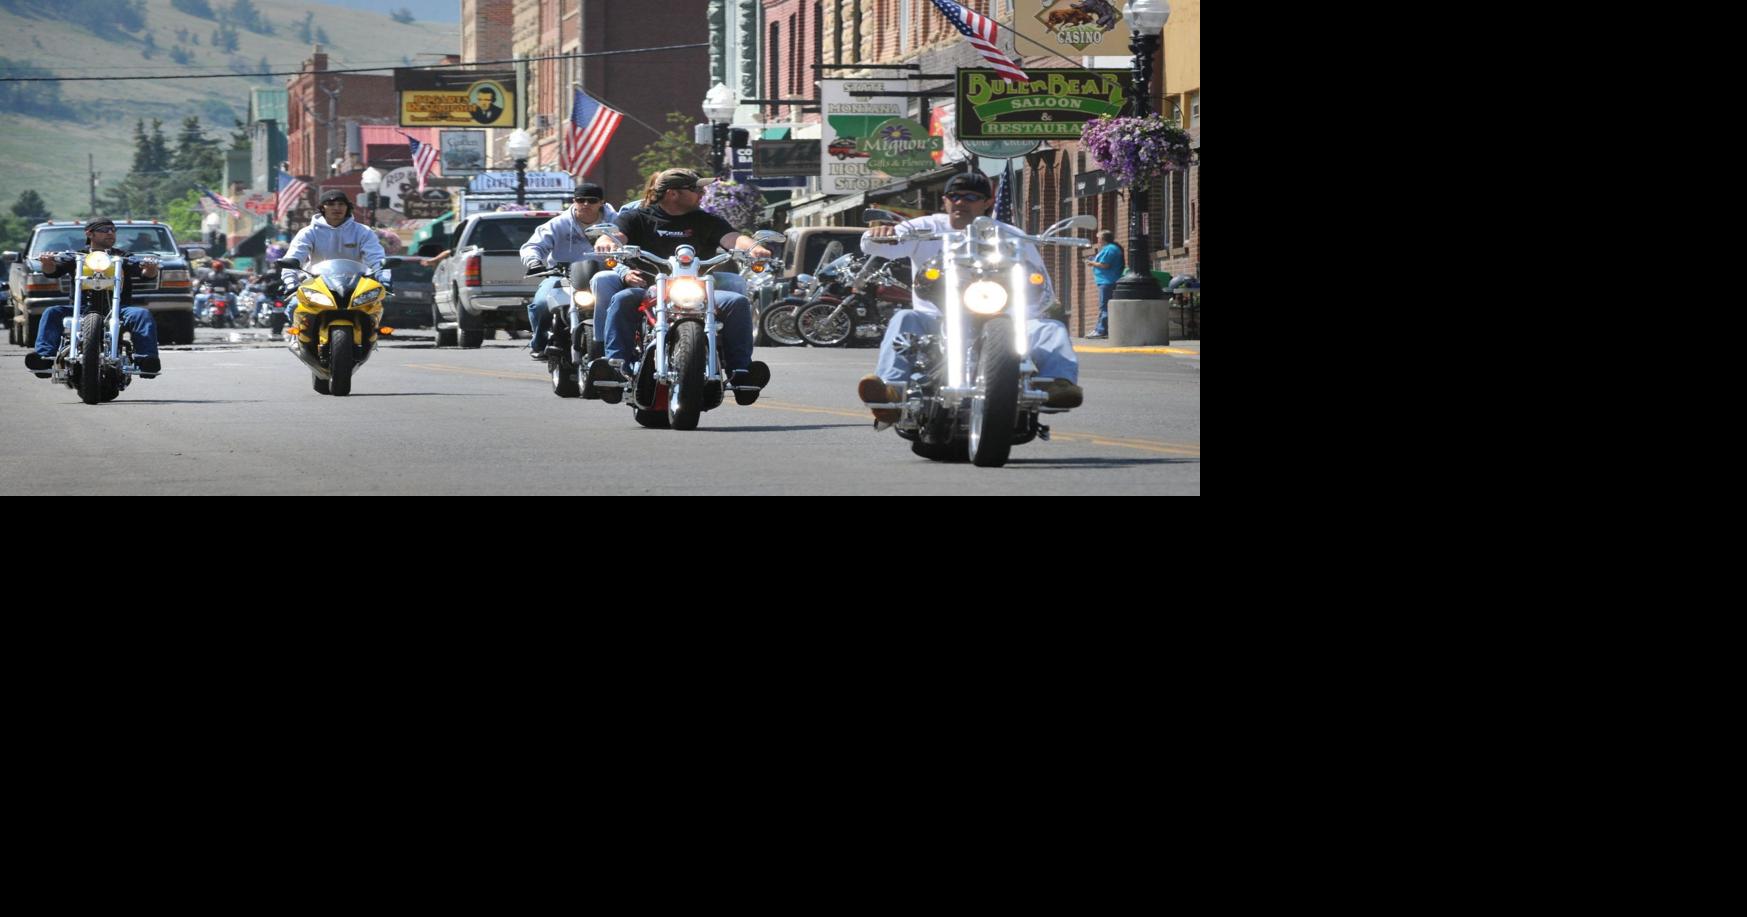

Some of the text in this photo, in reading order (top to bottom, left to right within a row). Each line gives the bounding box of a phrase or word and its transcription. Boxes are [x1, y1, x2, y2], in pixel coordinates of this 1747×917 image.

[1056, 30, 1103, 44] CASINO
[1048, 74, 1127, 106] BEAR
[828, 103, 900, 113] MONTANA
[1012, 98, 1082, 109] SALOON
[1041, 112, 1052, 121] &
[988, 123, 1082, 133] RESTAURA
[864, 138, 938, 157] Mignon's
[829, 163, 872, 176] LIQU
